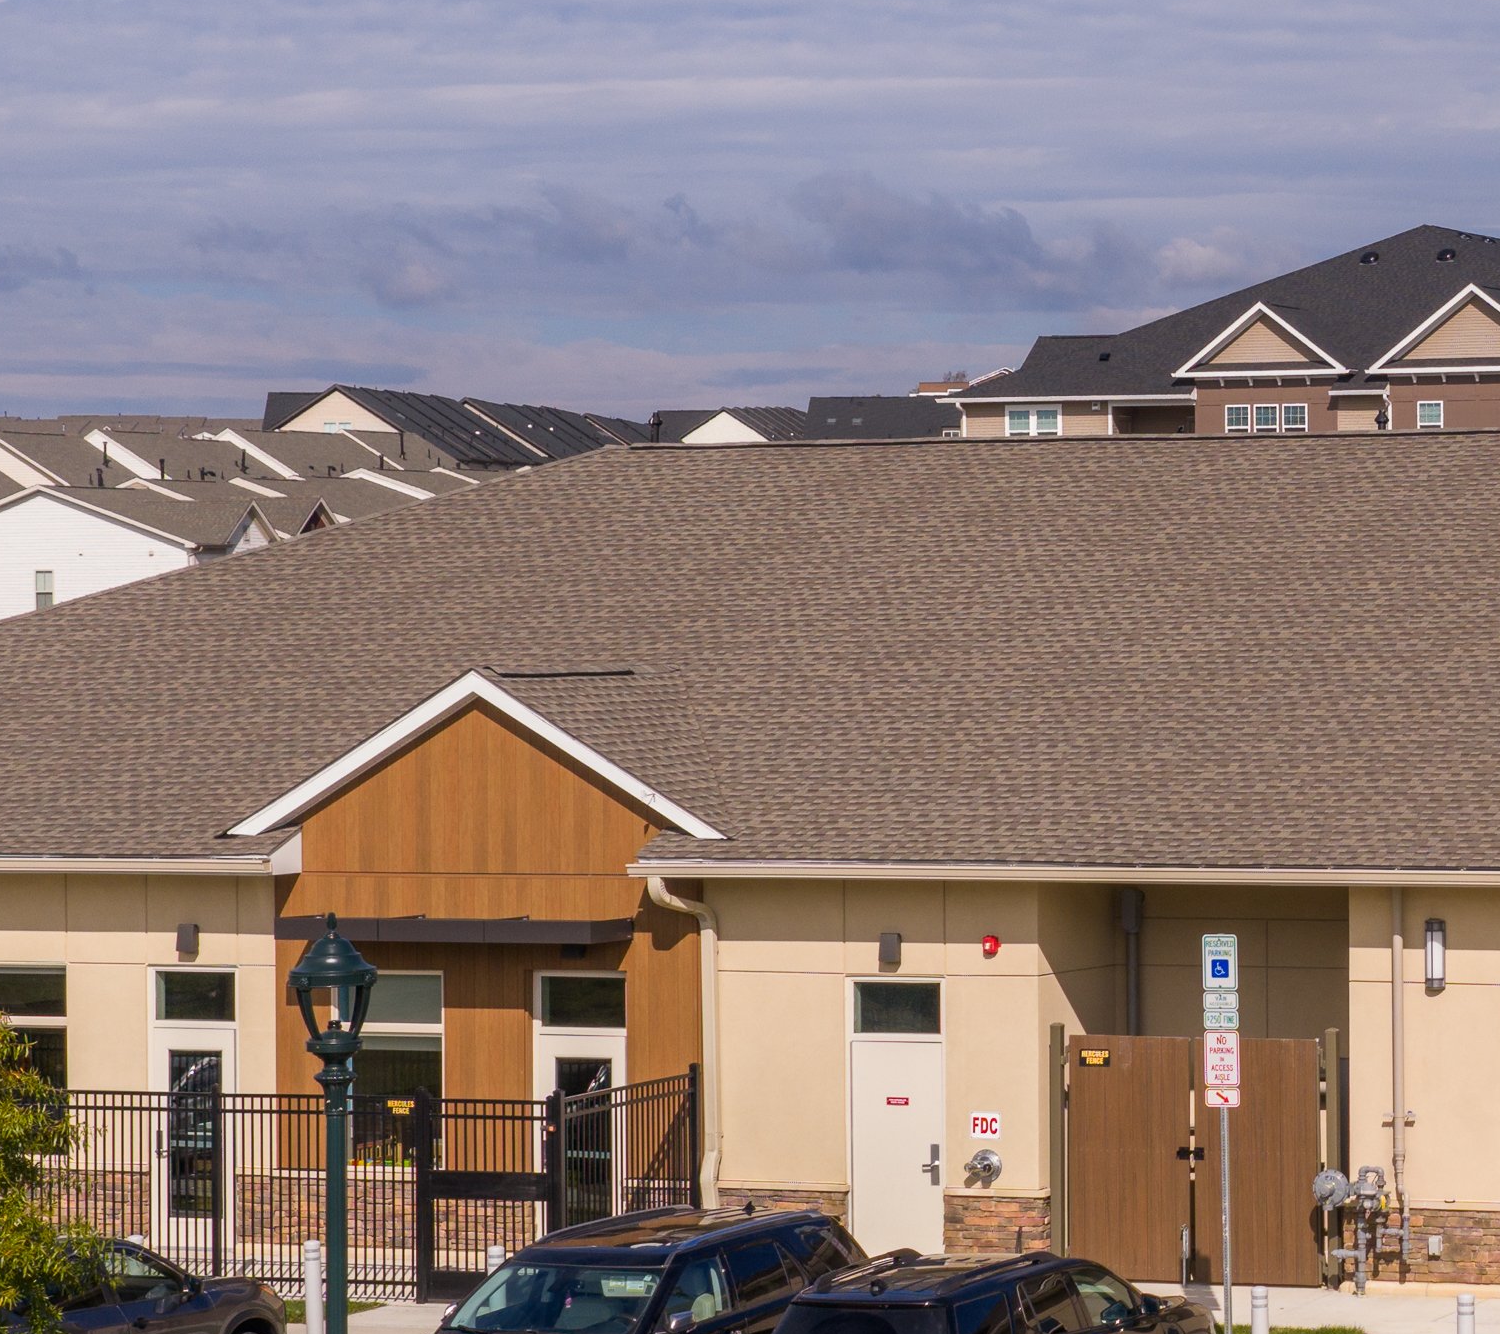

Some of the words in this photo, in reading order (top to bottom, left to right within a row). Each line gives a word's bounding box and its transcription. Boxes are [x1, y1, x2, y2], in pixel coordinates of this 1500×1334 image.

[1205, 940, 1233, 948] RESERVED
[1208, 949, 1232, 957] PARKING
[1216, 1036, 1227, 1045] NO
[1086, 1057, 1104, 1065] FENCE
[1211, 1064, 1234, 1072] ACCESS
[972, 1116, 998, 1135] FDC
